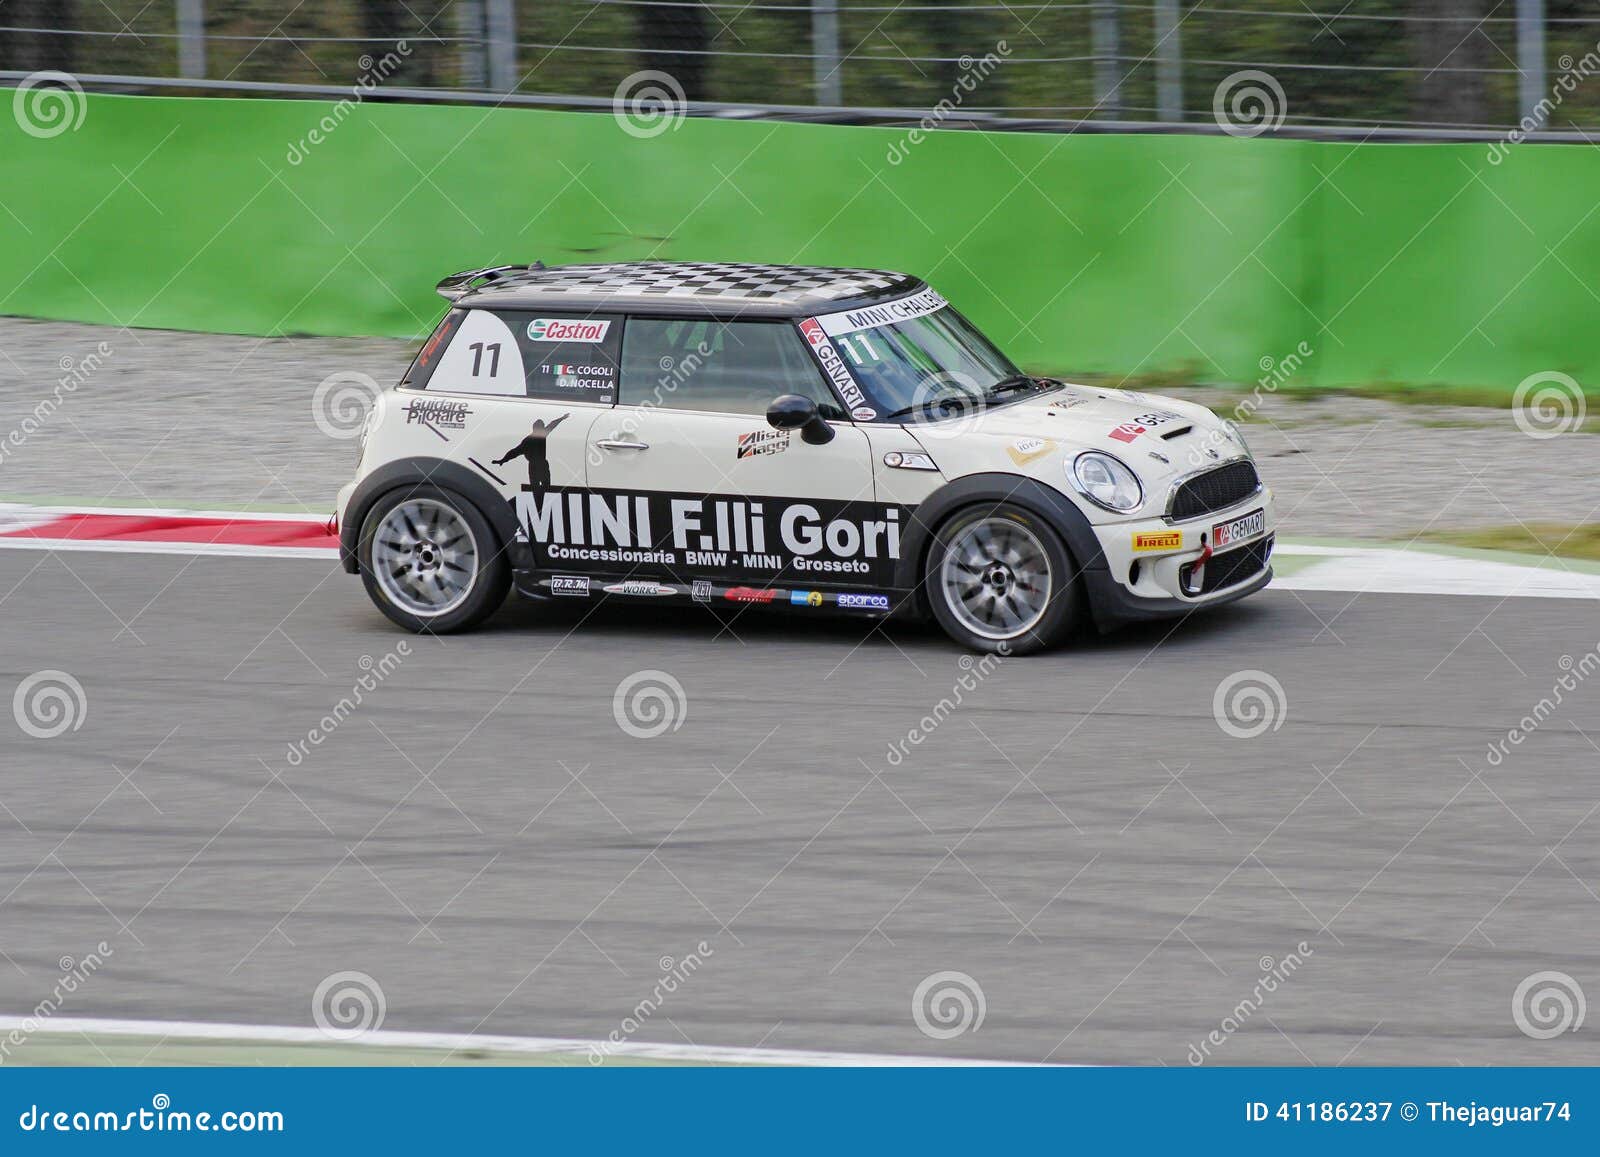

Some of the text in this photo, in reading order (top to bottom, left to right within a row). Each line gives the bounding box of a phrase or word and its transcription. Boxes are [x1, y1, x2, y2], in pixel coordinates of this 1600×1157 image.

[846, 307, 893, 329] MINI
[547, 322, 603, 339] Castrol
[838, 334, 880, 365] 11
[469, 342, 501, 377] 11
[541, 365, 550, 374] 11
[577, 366, 613, 376] COGOLI
[818, 345, 863, 407] GENART
[410, 398, 468, 412] Guidare
[407, 409, 466, 424] Pilotare
[515, 490, 653, 548] MINI
[780, 503, 900, 560] Gori
[1231, 512, 1264, 540] GENART
[1136, 533, 1179, 547] PIRELLI
[547, 544, 675, 565] Concessionaria
[685, 551, 727, 567] BMW
[743, 554, 782, 569] MINI
[793, 556, 870, 573] Grosseto
[623, 585, 659, 595] WORKS
[838, 594, 888, 607] sparco
